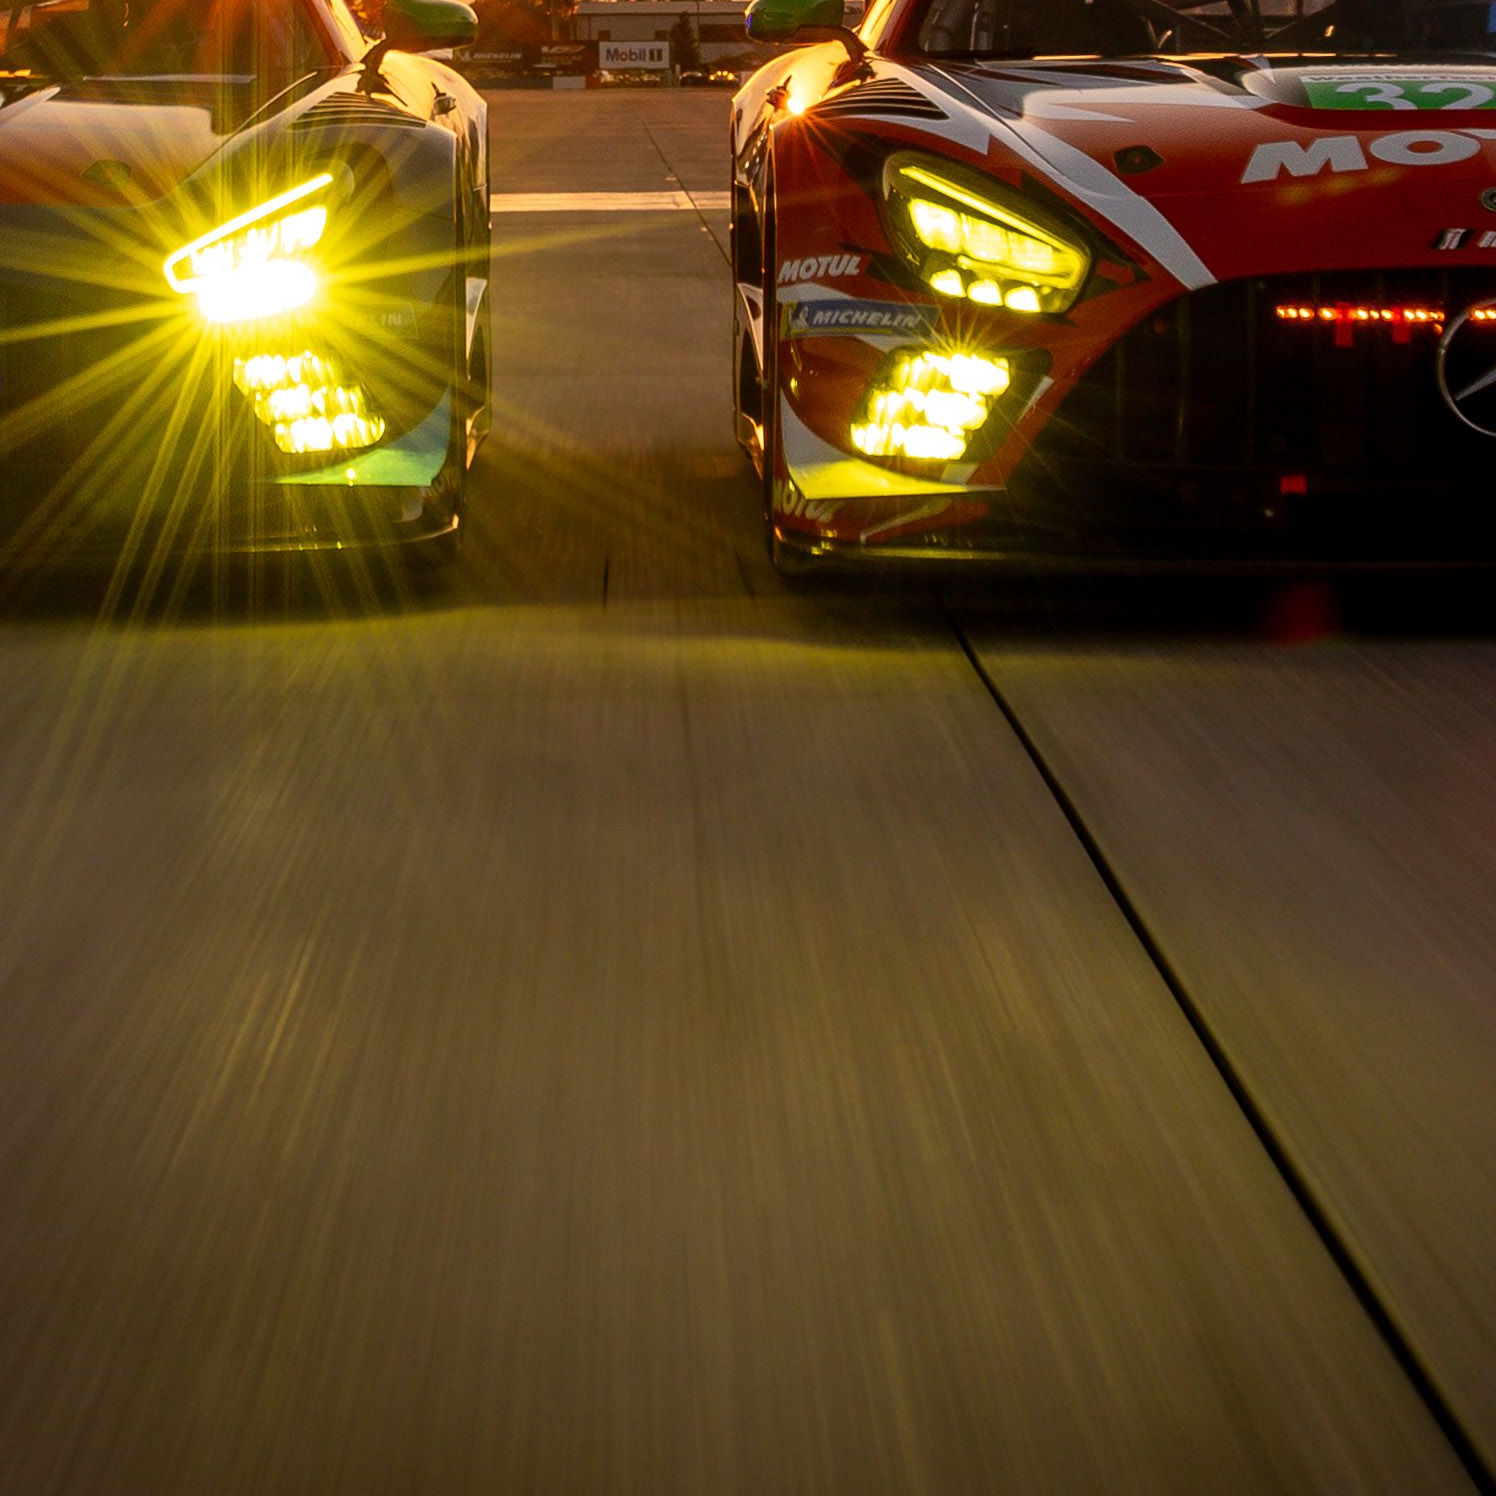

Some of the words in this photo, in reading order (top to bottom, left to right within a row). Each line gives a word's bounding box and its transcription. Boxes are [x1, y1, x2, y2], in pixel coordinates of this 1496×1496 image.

[606, 49, 646, 63] Mobil
[778, 255, 861, 283] MOTUL
[813, 310, 921, 328] MICHELIN
